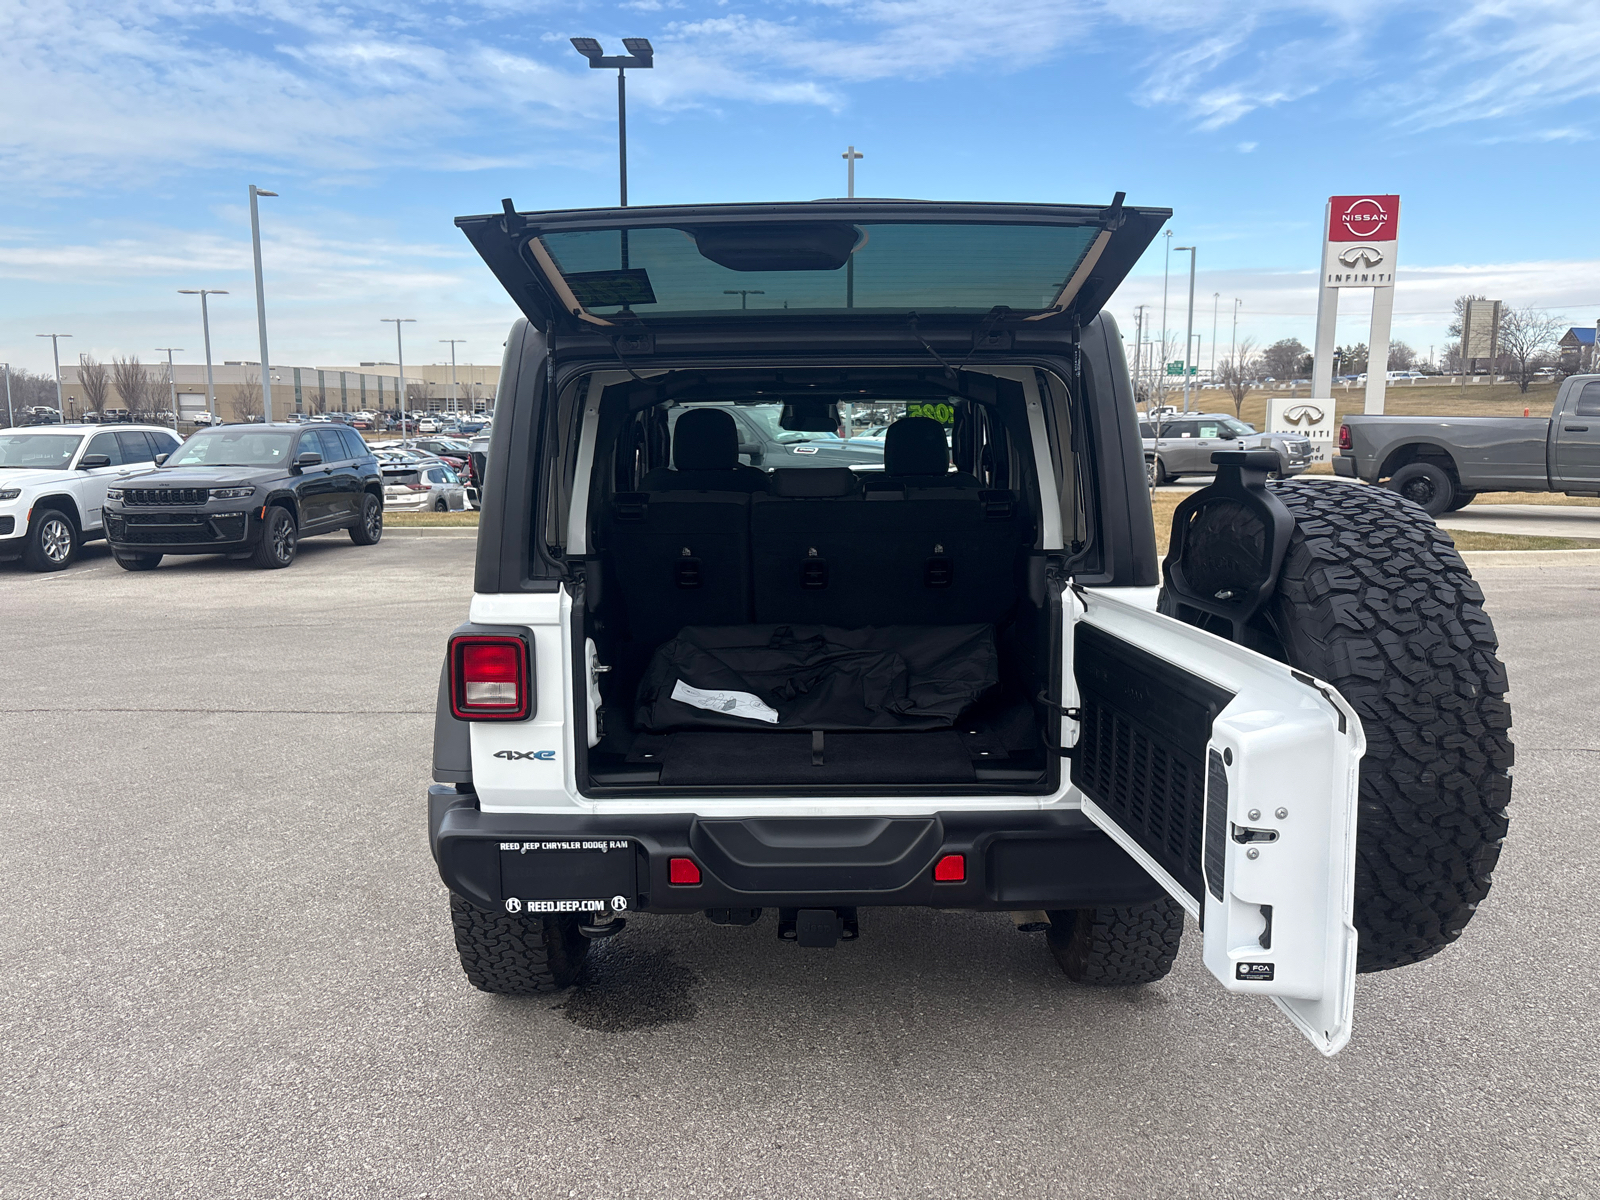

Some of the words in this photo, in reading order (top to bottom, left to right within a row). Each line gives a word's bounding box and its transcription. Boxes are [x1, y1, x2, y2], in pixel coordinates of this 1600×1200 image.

[1328, 274, 1391, 282] INFINITI
[500, 842, 520, 850] REED
[522, 842, 540, 850] JEEP
[541, 841, 581, 849] CHRYSLER
[582, 841, 608, 849] DODGE
[609, 840, 628, 848] RAM
[527, 901, 605, 912] REEDJEEP.COM
[802, 922, 832, 933] Jeep
